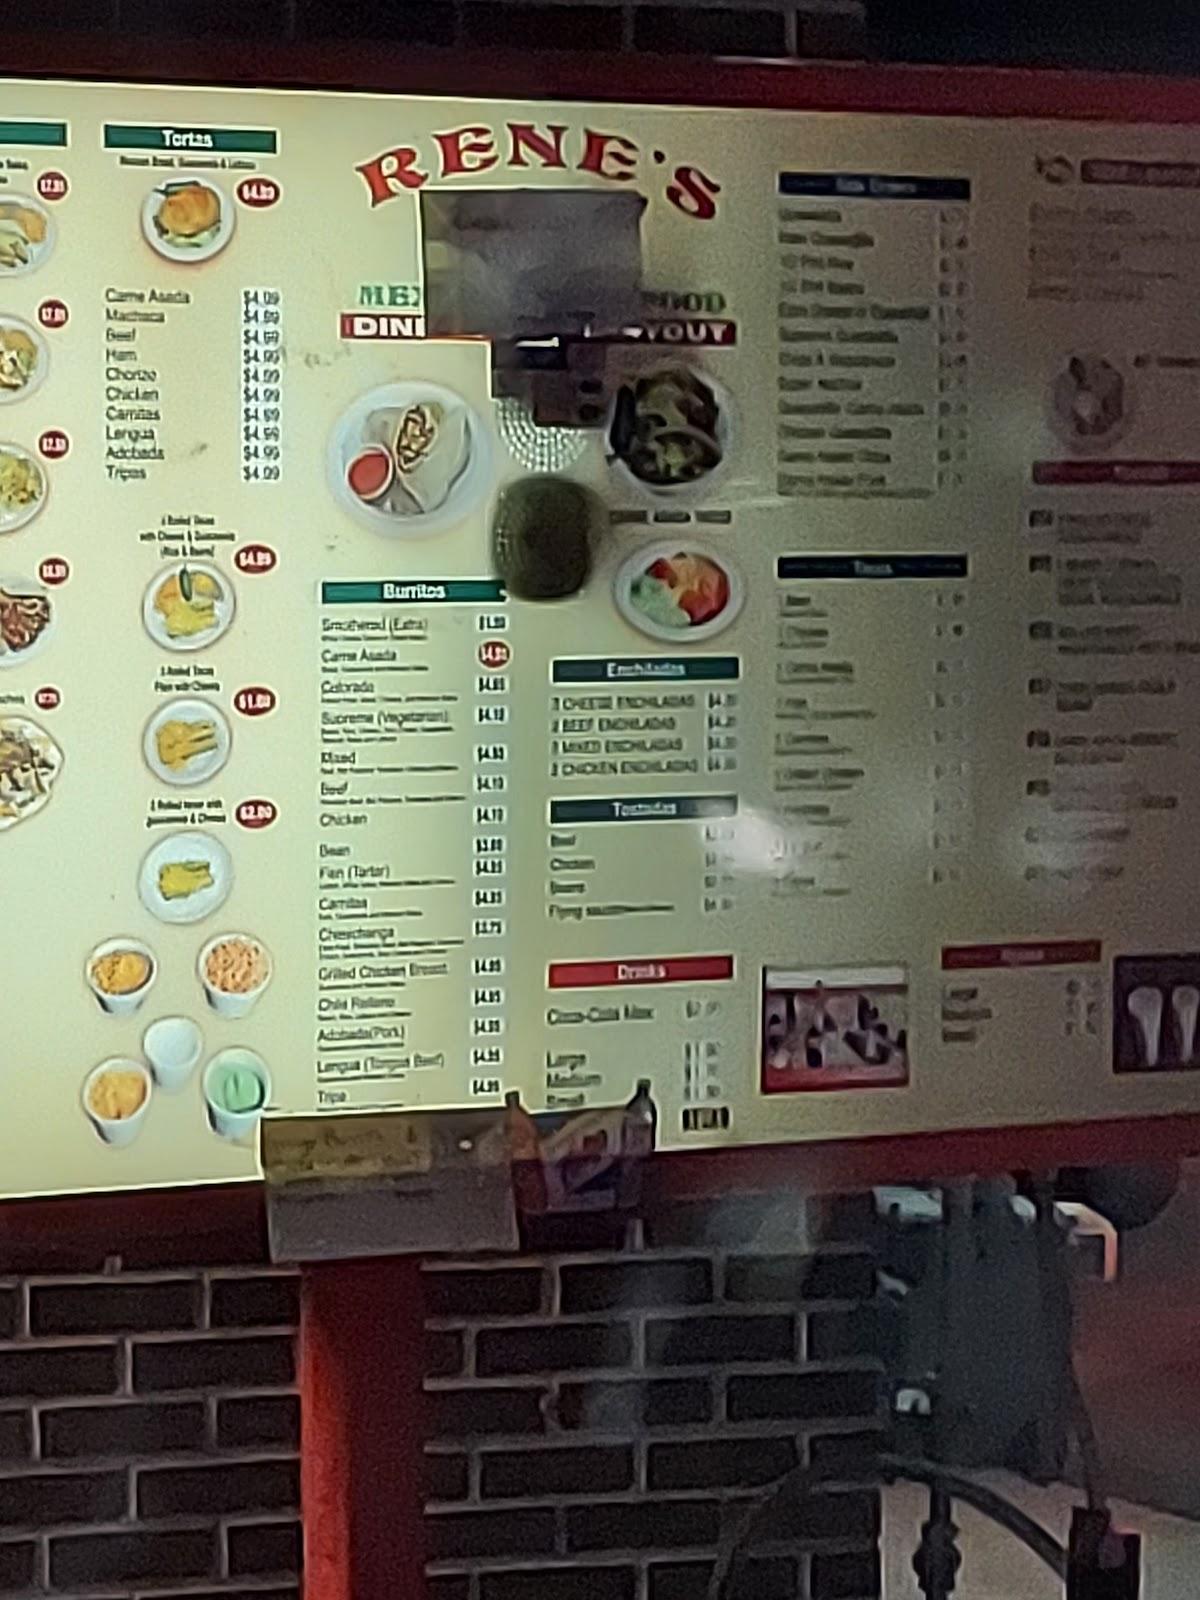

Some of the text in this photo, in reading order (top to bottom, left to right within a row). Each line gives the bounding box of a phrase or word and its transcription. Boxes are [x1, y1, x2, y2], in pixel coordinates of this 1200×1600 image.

[162, 129, 213, 148] Tortas
[356, 123, 720, 220] RENE'S
[383, 583, 446, 600] Burritos
